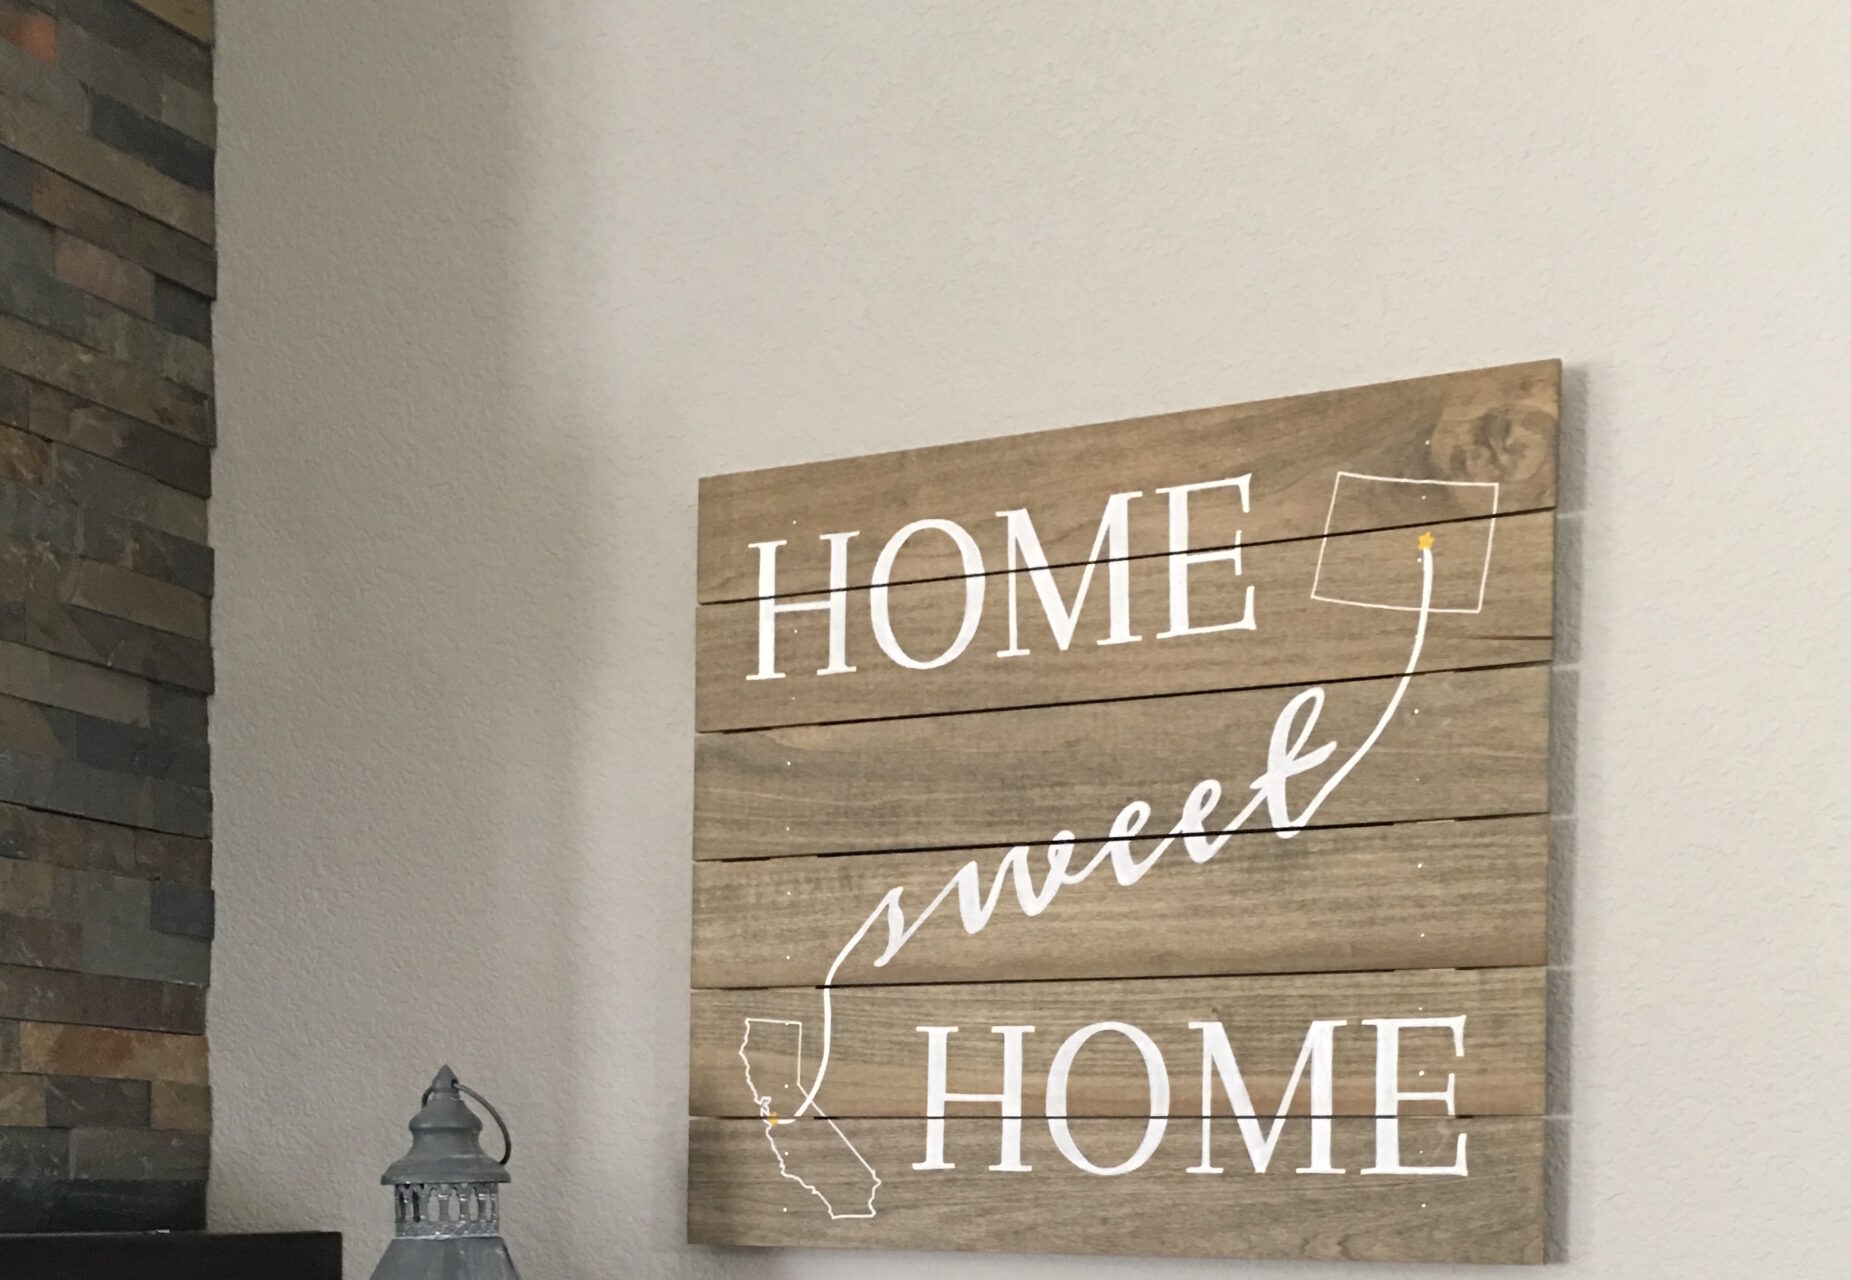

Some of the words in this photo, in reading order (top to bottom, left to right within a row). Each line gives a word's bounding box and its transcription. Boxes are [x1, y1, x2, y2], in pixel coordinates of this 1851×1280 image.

[745, 473, 1257, 681] HOME
[871, 685, 1338, 968] sweet
[912, 1014, 1470, 1177] HOME
